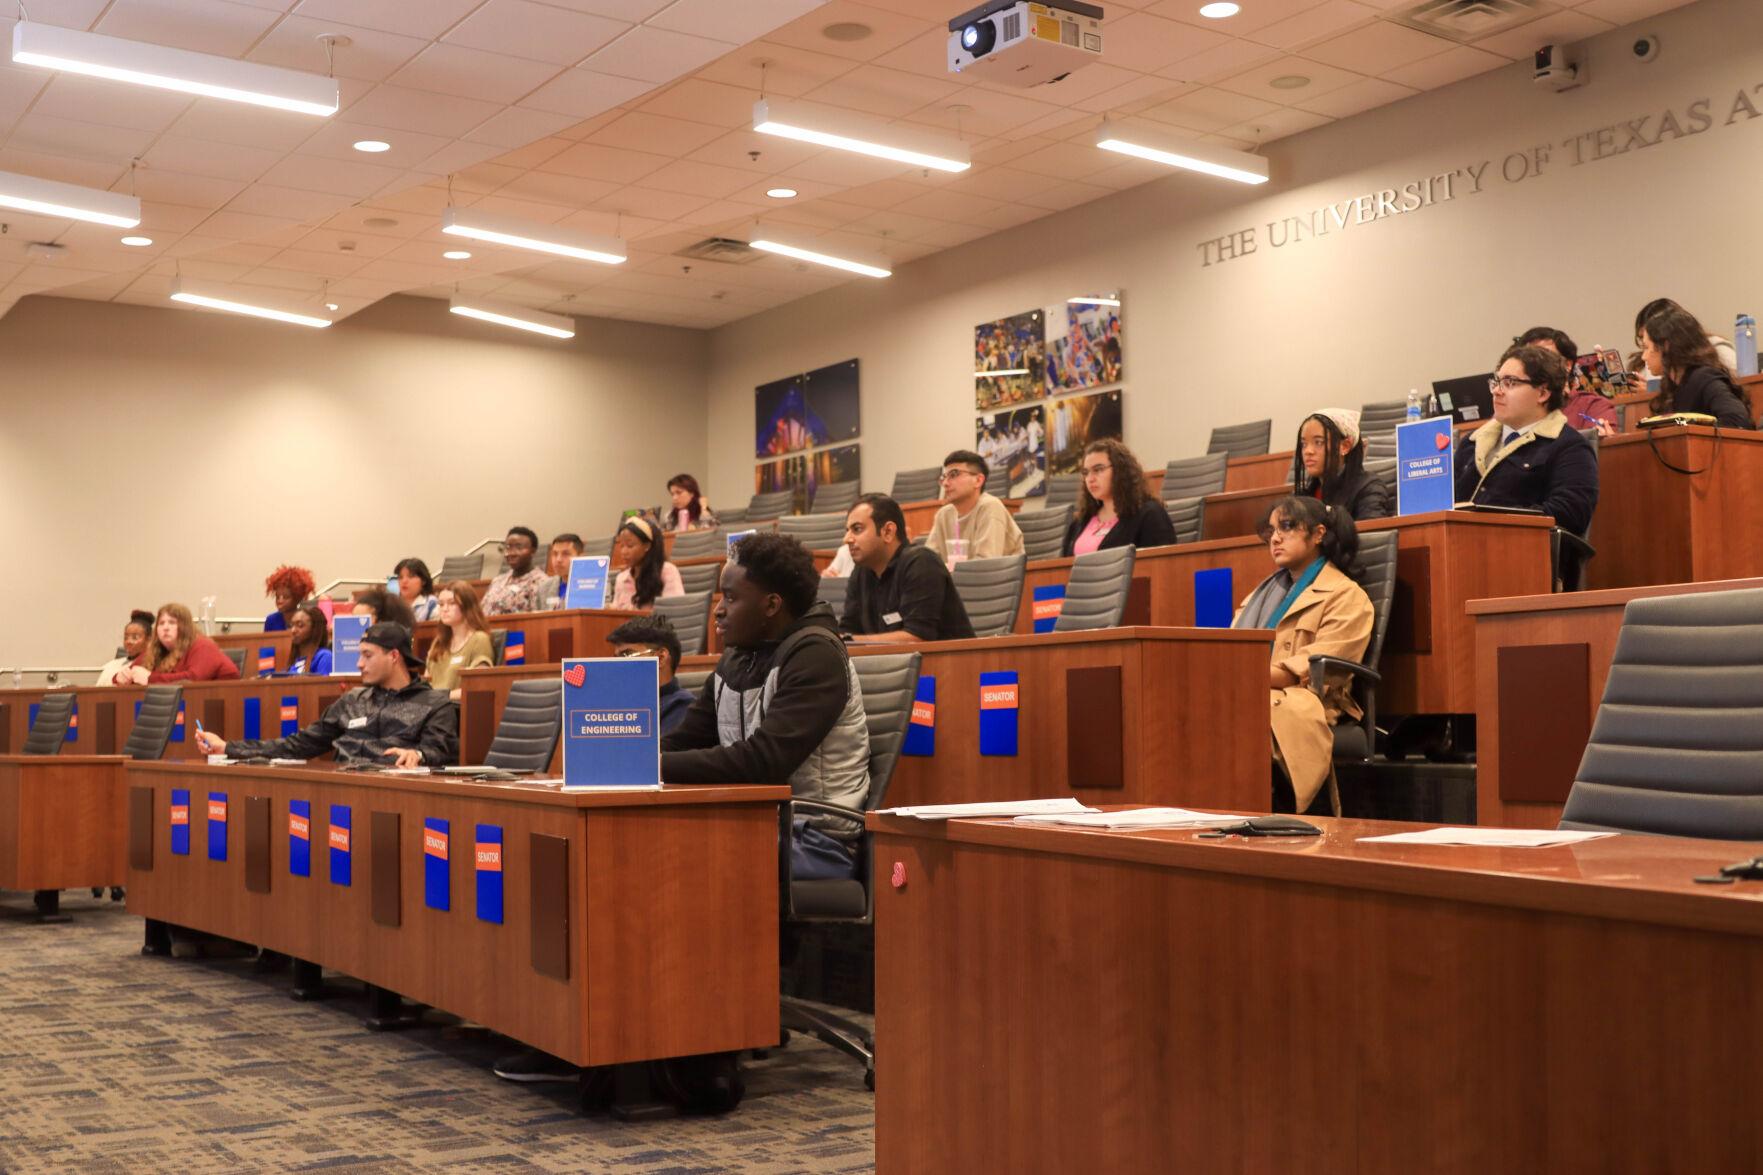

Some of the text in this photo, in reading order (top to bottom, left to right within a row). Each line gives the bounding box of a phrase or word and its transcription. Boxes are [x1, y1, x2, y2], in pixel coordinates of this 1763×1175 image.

[1196, 227, 1258, 267] THE
[1266, 160, 1491, 248] UNIVERSITY
[1502, 143, 1553, 183] OF
[1563, 98, 1713, 167] TEXAS
[1409, 459, 1432, 468] COLLEGE
[1408, 466, 1443, 478] LIBERAL ARTS
[984, 691, 1015, 702] SENATOR
[585, 713, 638, 721] COLLEGE OF
[581, 725, 642, 735] ENGINEERING
[426, 836, 446, 851] SENATOR
[477, 852, 499, 863] SENATOR
